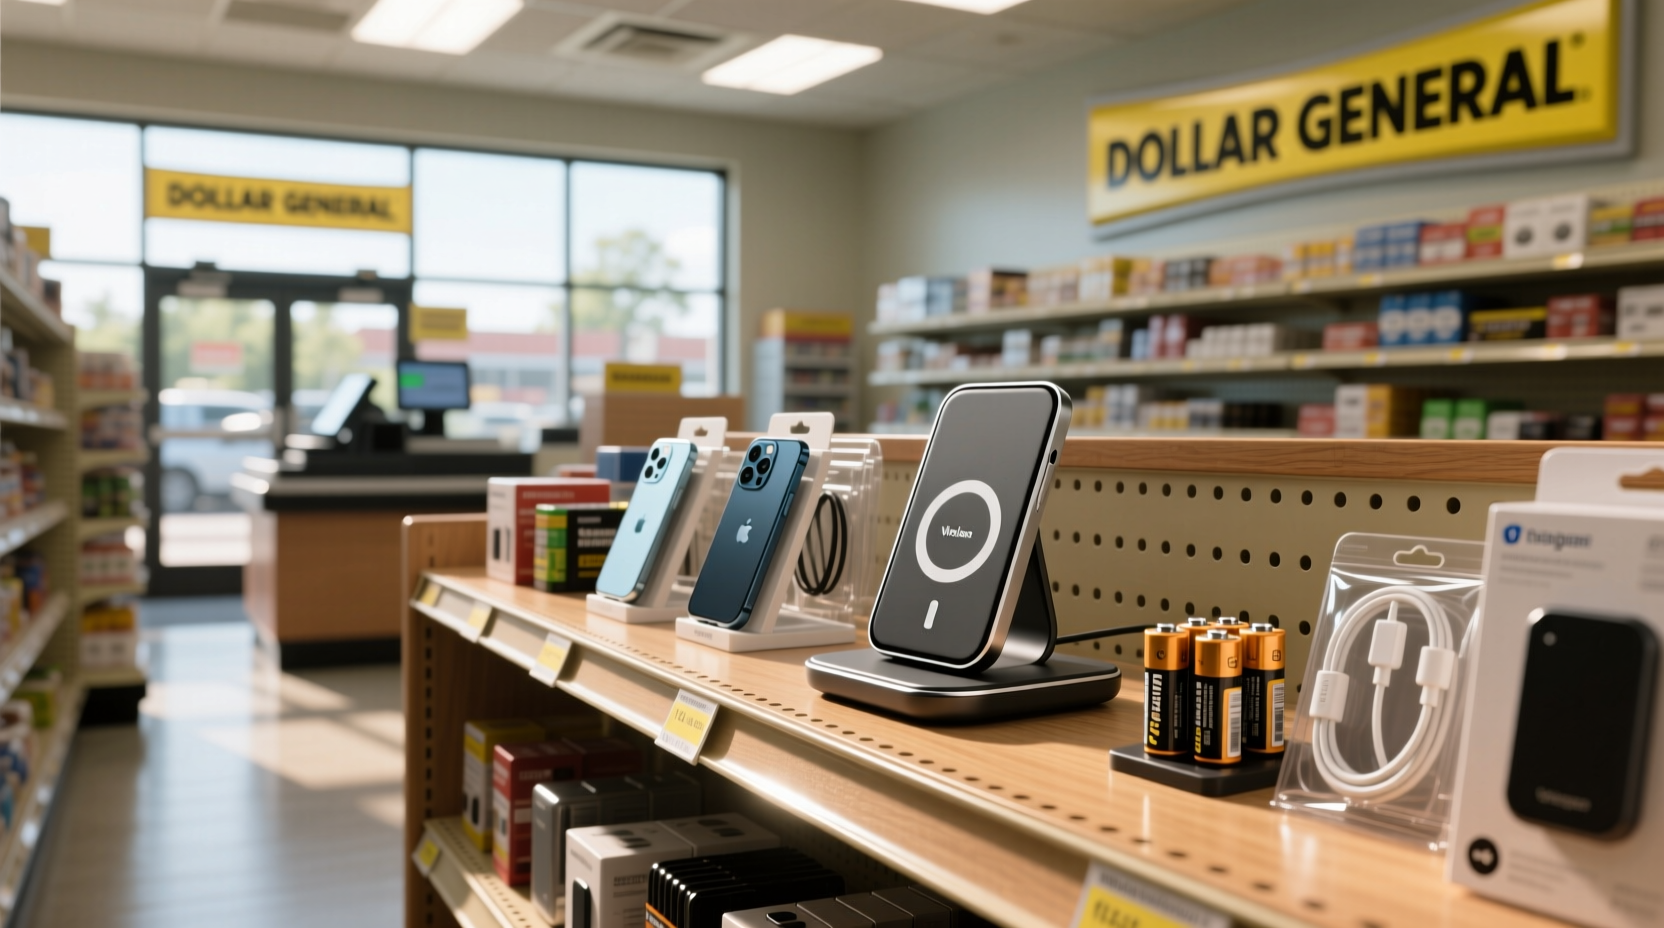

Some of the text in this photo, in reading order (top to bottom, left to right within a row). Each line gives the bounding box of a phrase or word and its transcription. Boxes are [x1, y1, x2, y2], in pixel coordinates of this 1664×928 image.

[1106, 39, 1575, 190] DOLLAR GENERAL
[167, 182, 394, 222] DOLLAR GENERAL
